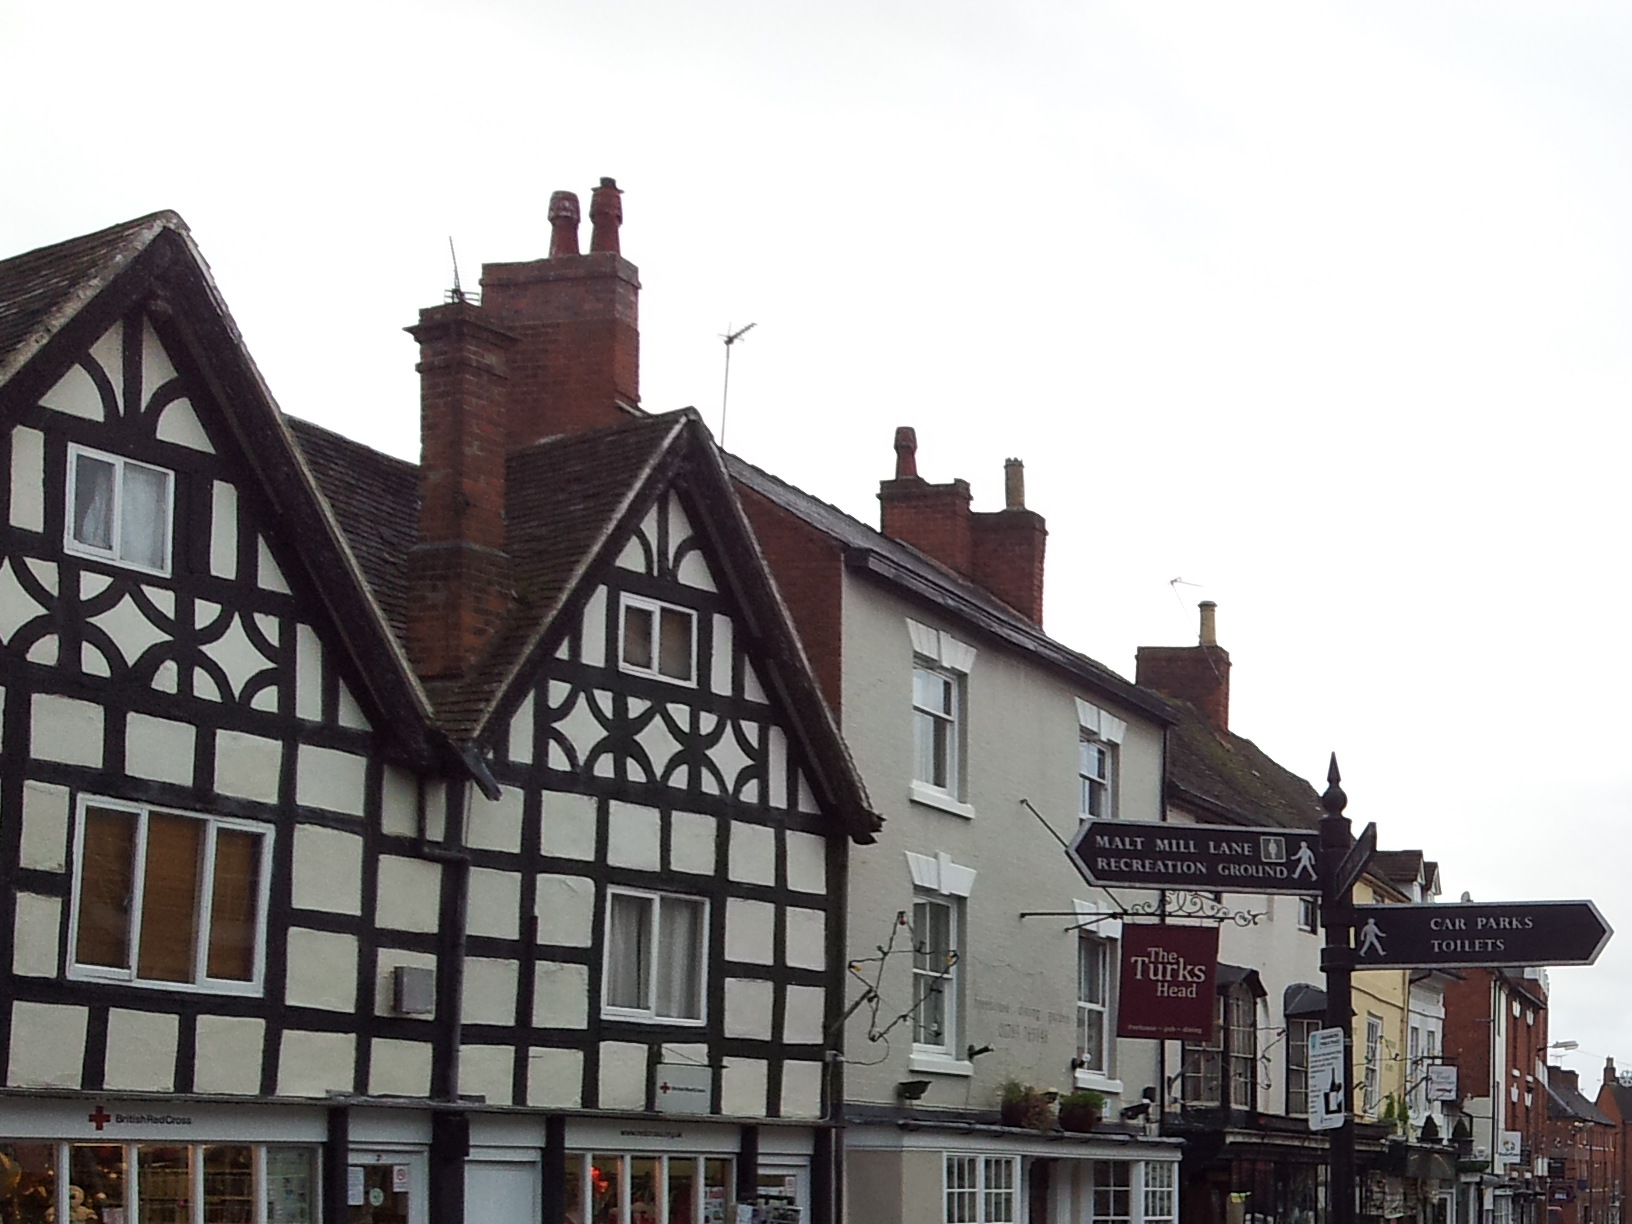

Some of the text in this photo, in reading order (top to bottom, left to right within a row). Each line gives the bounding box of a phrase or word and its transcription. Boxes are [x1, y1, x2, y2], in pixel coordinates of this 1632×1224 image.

[1096, 835, 1253, 856] MALT MILL LANE
[1097, 857, 1288, 879] RECREATION GROUND
[1430, 916, 1533, 930] CAR PARKS
[1431, 939, 1505, 952] TOILETS
[1147, 947, 1178, 962] The
[1130, 956, 1206, 982] Turks
[1156, 982, 1197, 998] Head
